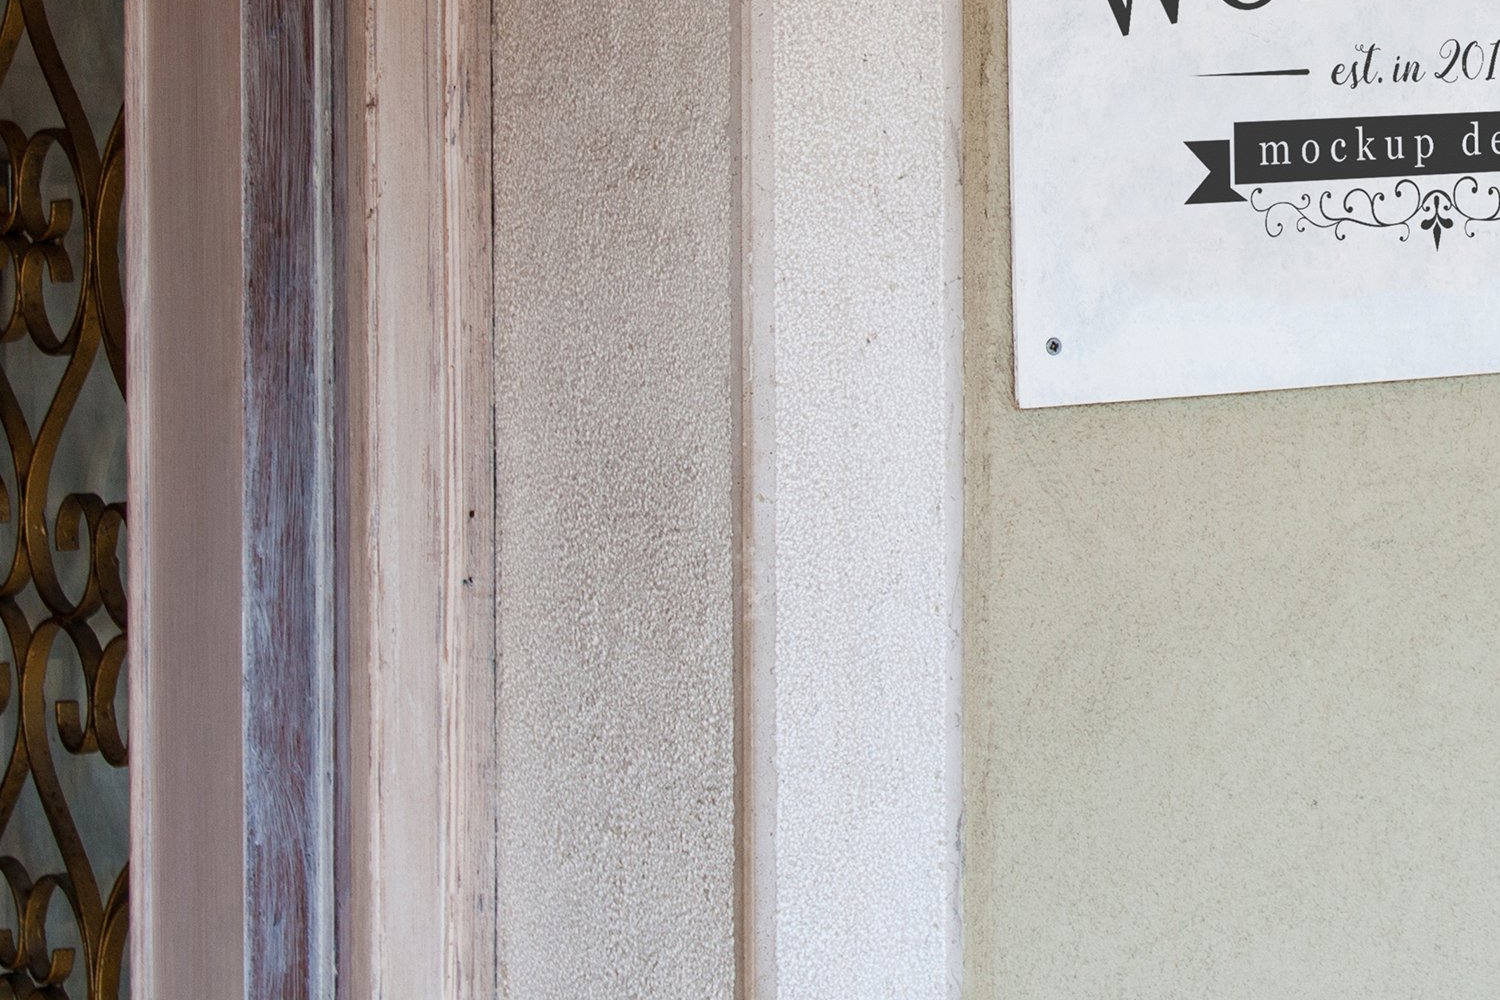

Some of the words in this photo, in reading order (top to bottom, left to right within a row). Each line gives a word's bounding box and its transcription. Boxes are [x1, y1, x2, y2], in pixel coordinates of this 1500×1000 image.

[1331, 42, 1383, 90] est.
[1392, 55, 1426, 83] in
[1258, 125, 1435, 168] mockup
